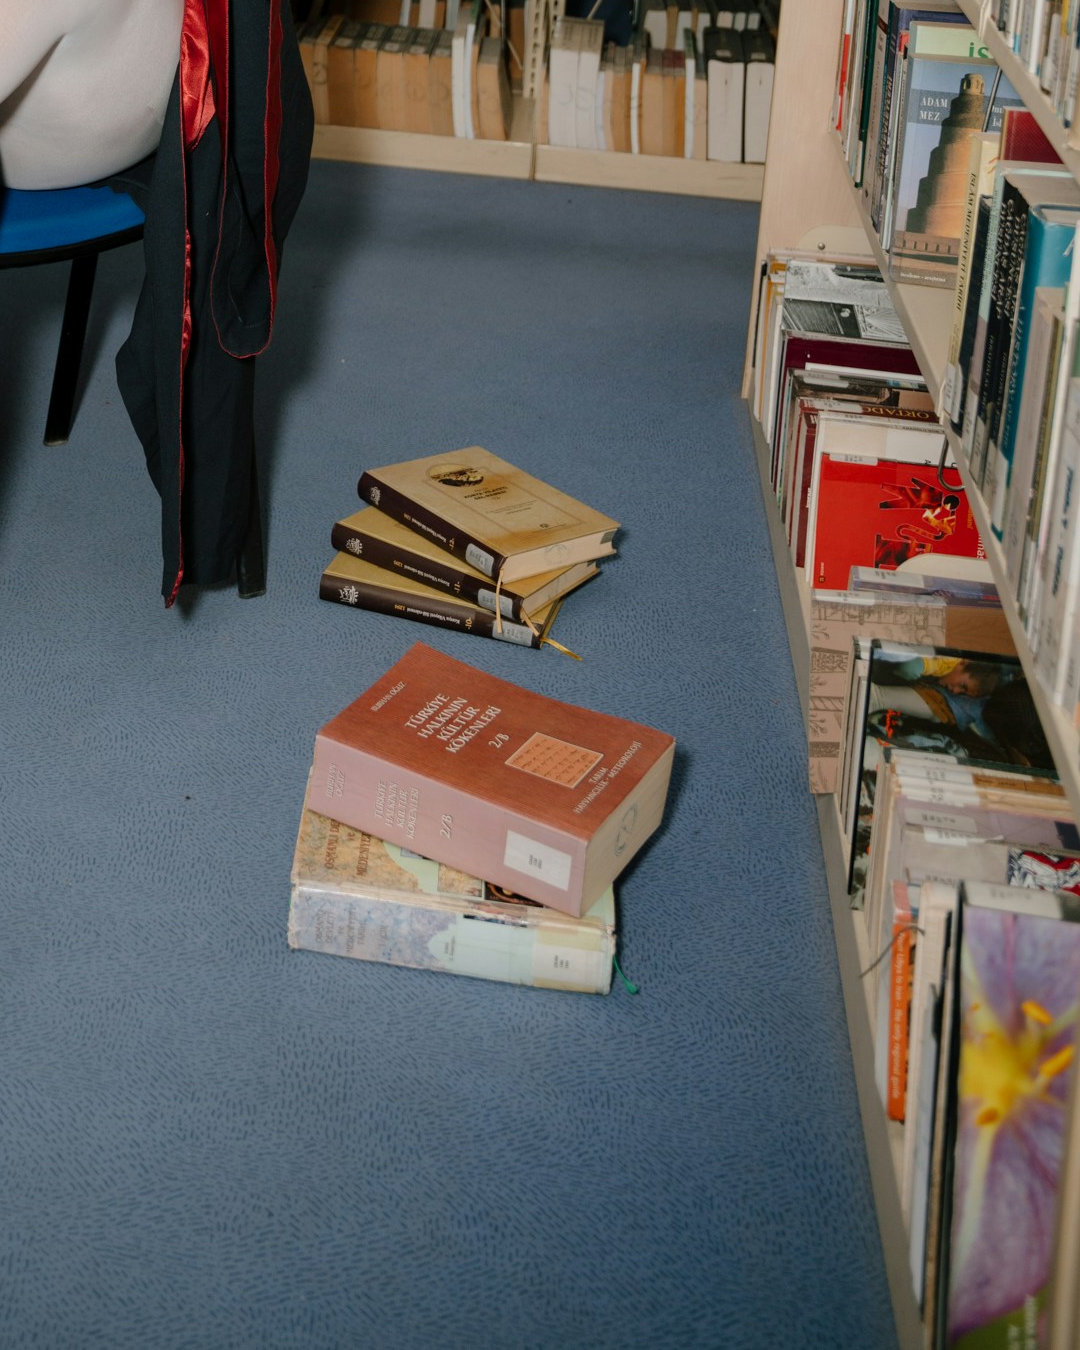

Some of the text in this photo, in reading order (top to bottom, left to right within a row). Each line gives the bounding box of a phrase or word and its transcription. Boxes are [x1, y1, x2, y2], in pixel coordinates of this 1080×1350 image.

[920, 97, 949, 108] ADAM
[920, 110, 941, 122] MEZ
[960, 213, 972, 278] MEDENİYETİ
[956, 279, 965, 312] TARİHİ
[388, 681, 407, 698] OĞUZ
[404, 693, 451, 730] TÜRKİYE
[417, 696, 469, 739] HALKININ
[436, 705, 481, 742] KÜLTÜR
[445, 705, 502, 754] KÖKENLERİ
[488, 732, 511, 749] 2/B
[326, 763, 337, 798] BURHAN
[336, 771, 346, 797] OĞUZ
[574, 740, 642, 815] HAYVANCILIK METEOROLOJİ
[587, 767, 609, 785] TARIM
[374, 779, 388, 818] TÜRKİYE
[384, 780, 398, 829] HALKININ
[396, 789, 409, 829] KÜLTÜR
[406, 787, 420, 839] KÖKENLERİ
[347, 832, 356, 841] ve
[439, 813, 454, 839] 2/B
[324, 831, 338, 871] OSMANLI
